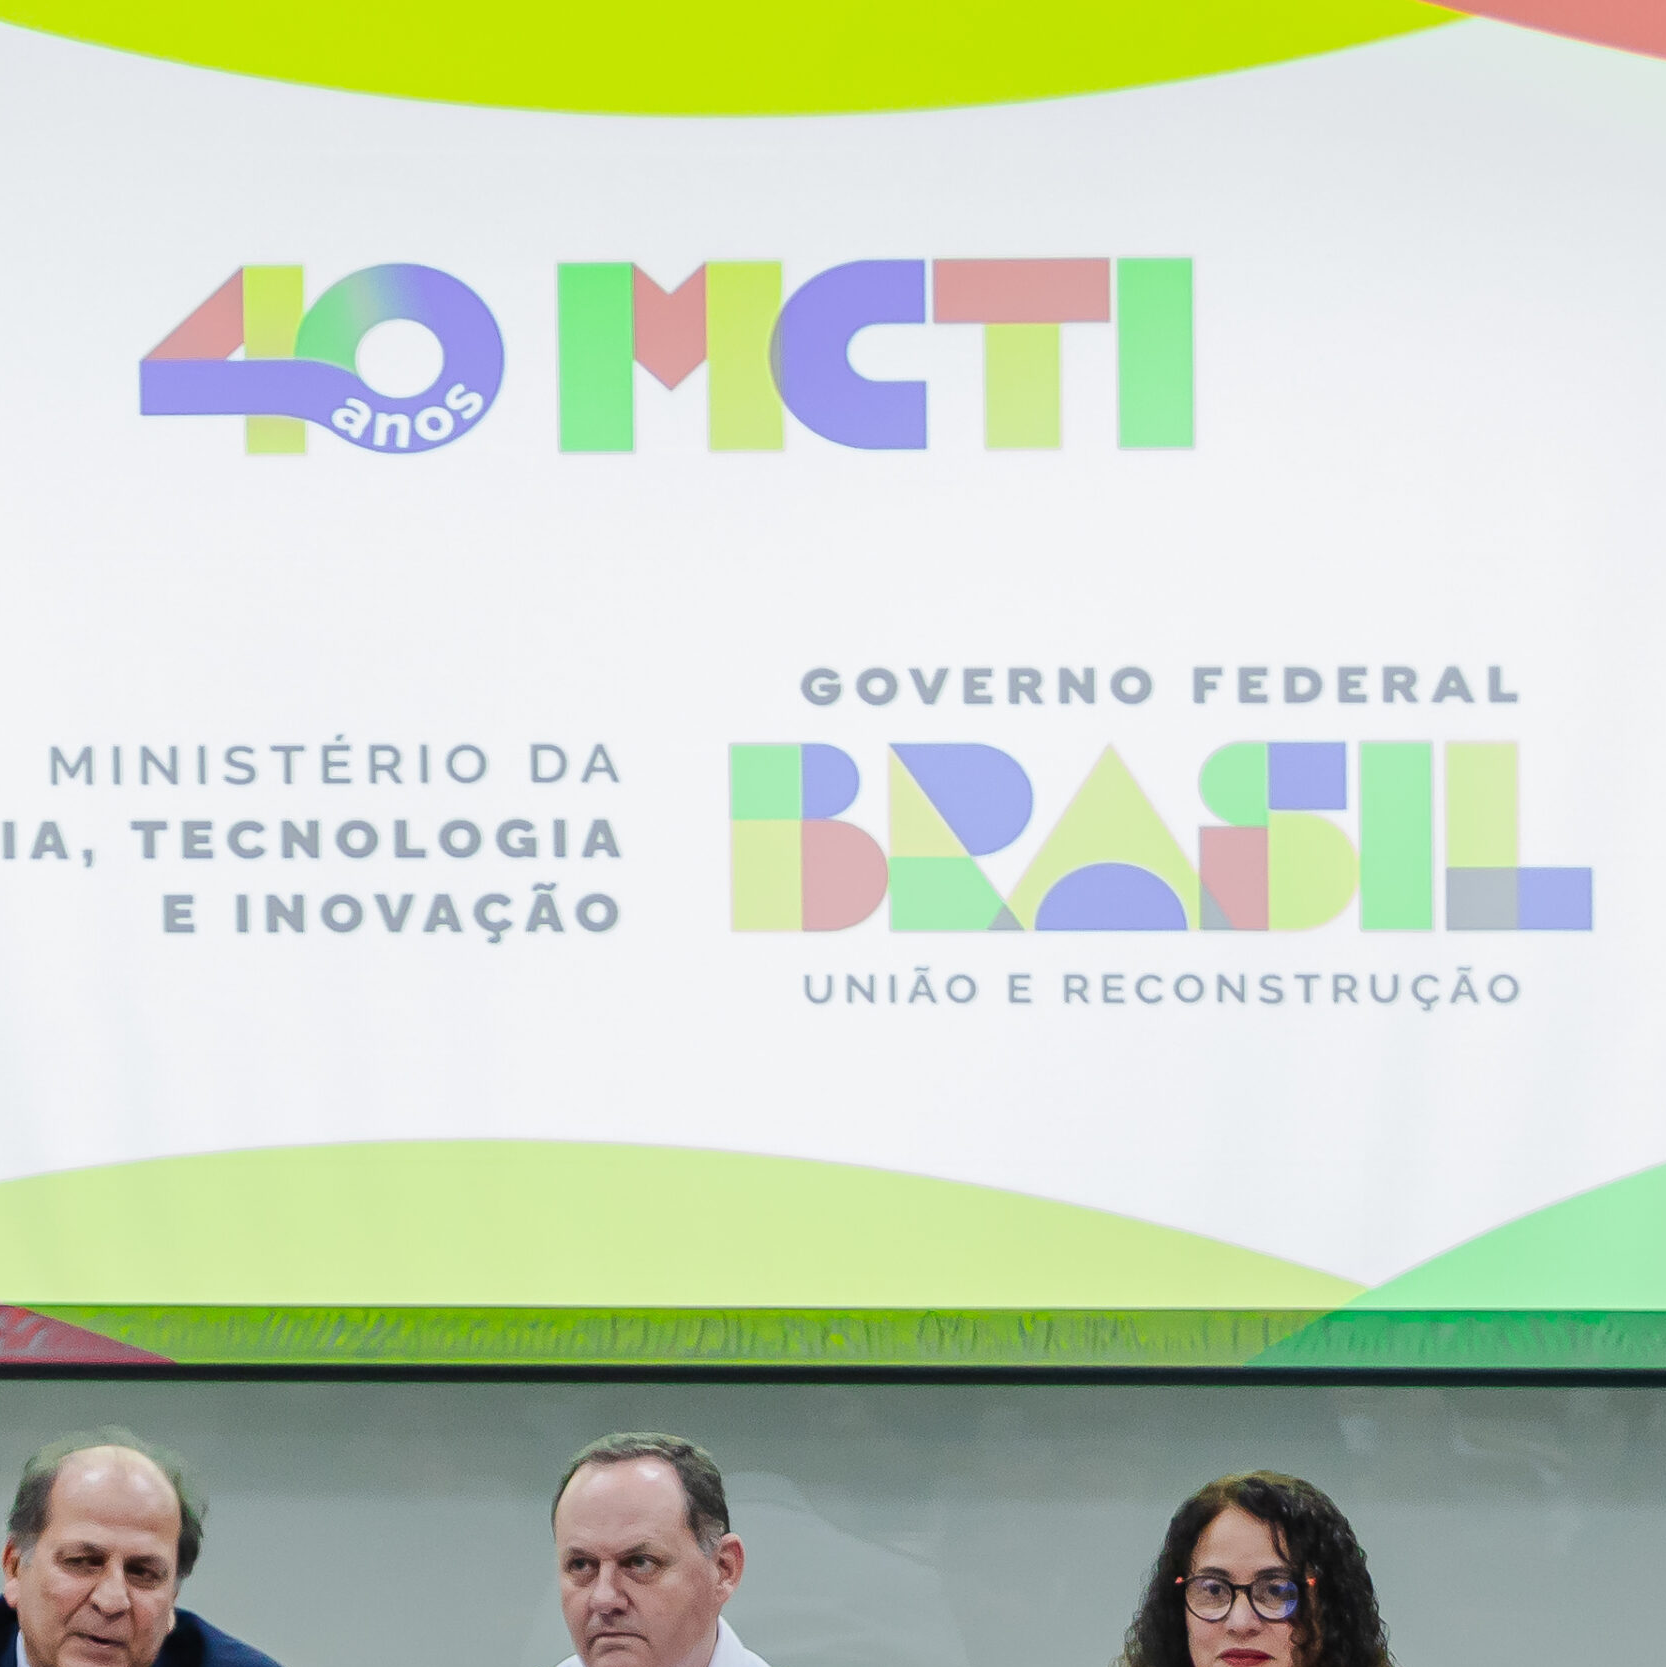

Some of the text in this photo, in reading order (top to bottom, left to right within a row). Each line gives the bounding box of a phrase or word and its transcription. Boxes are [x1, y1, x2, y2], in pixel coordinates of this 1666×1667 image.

[139, 257, 1195, 455] 40 MCTI
[331, 383, 485, 449] anos
[798, 664, 1520, 707] GOVERNO FEDERAL
[49, 732, 621, 786] MINISTÉRIO DA
[128, 819, 622, 863] TECNOLOGIA
[729, 741, 1594, 932] BRASIL
[161, 881, 621, 945] E INOVAÇÃO
[803, 965, 1521, 1012] UNIÃO E RECONSTRUÇÃO
